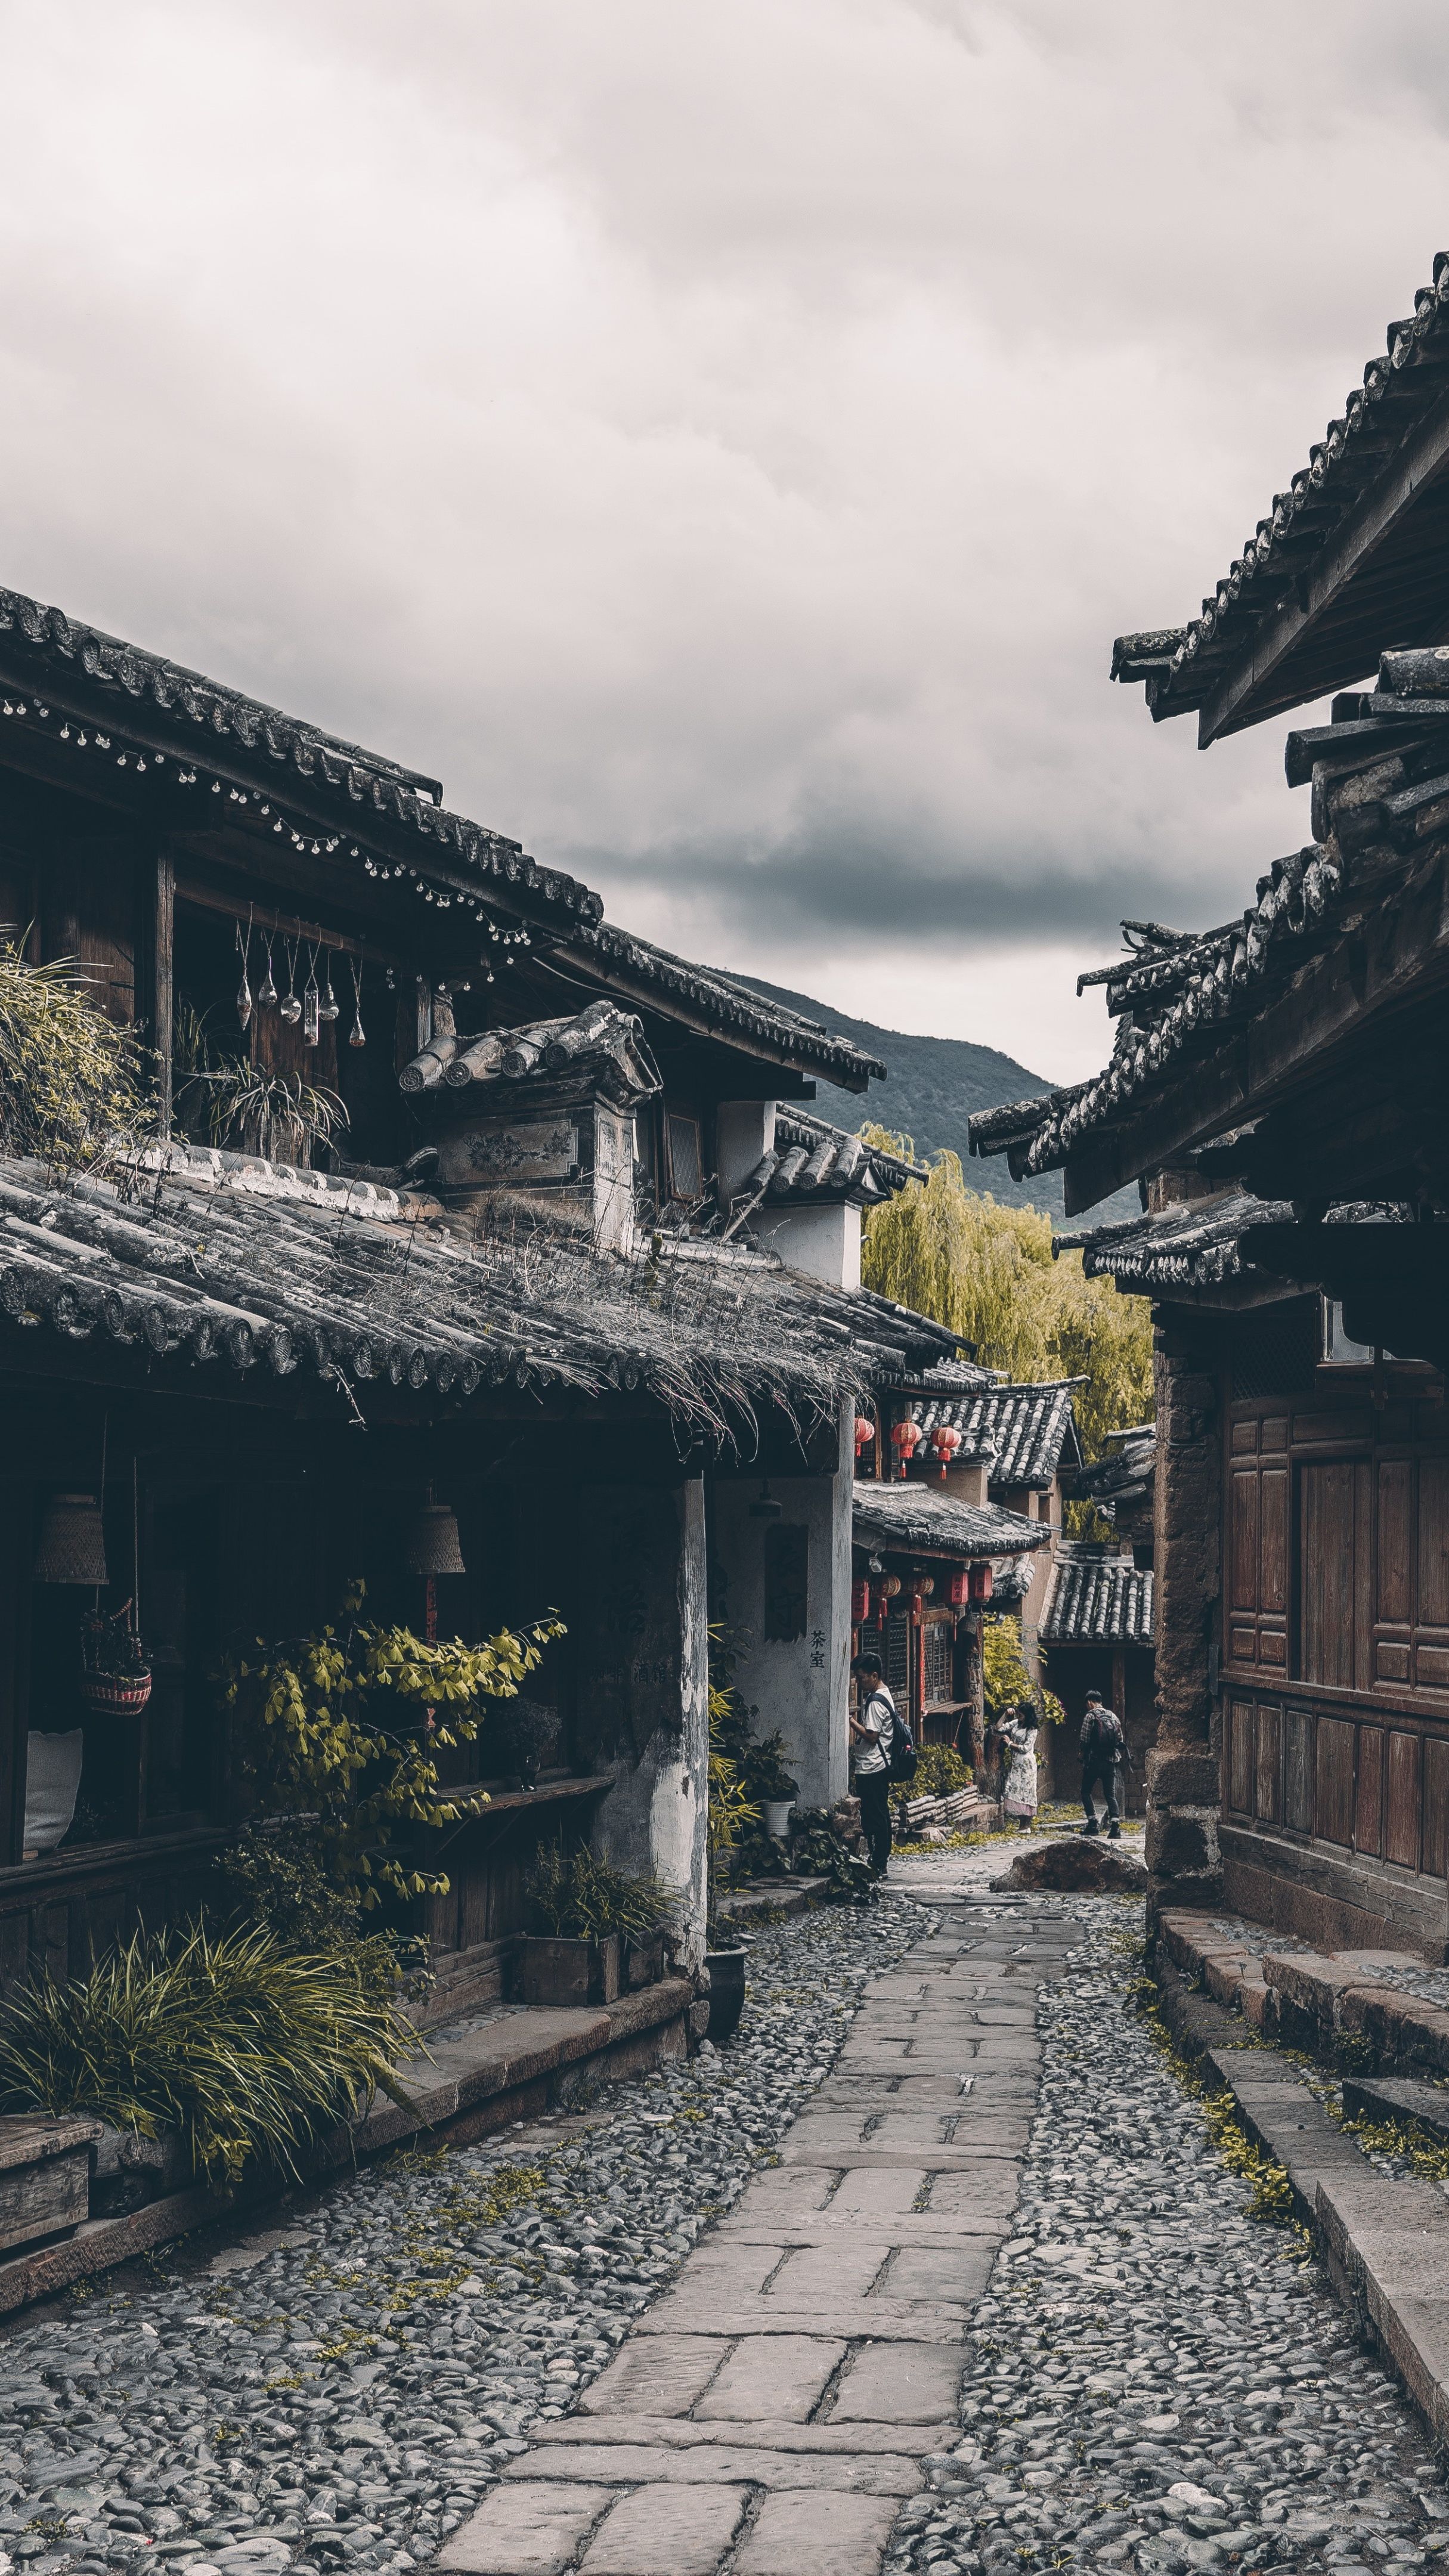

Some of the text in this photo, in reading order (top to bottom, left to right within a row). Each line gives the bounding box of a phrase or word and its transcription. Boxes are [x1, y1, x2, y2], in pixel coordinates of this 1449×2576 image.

[808, 1630, 826, 1668] 茶室
[588, 1662, 667, 1685] 咖啡 酒馆
